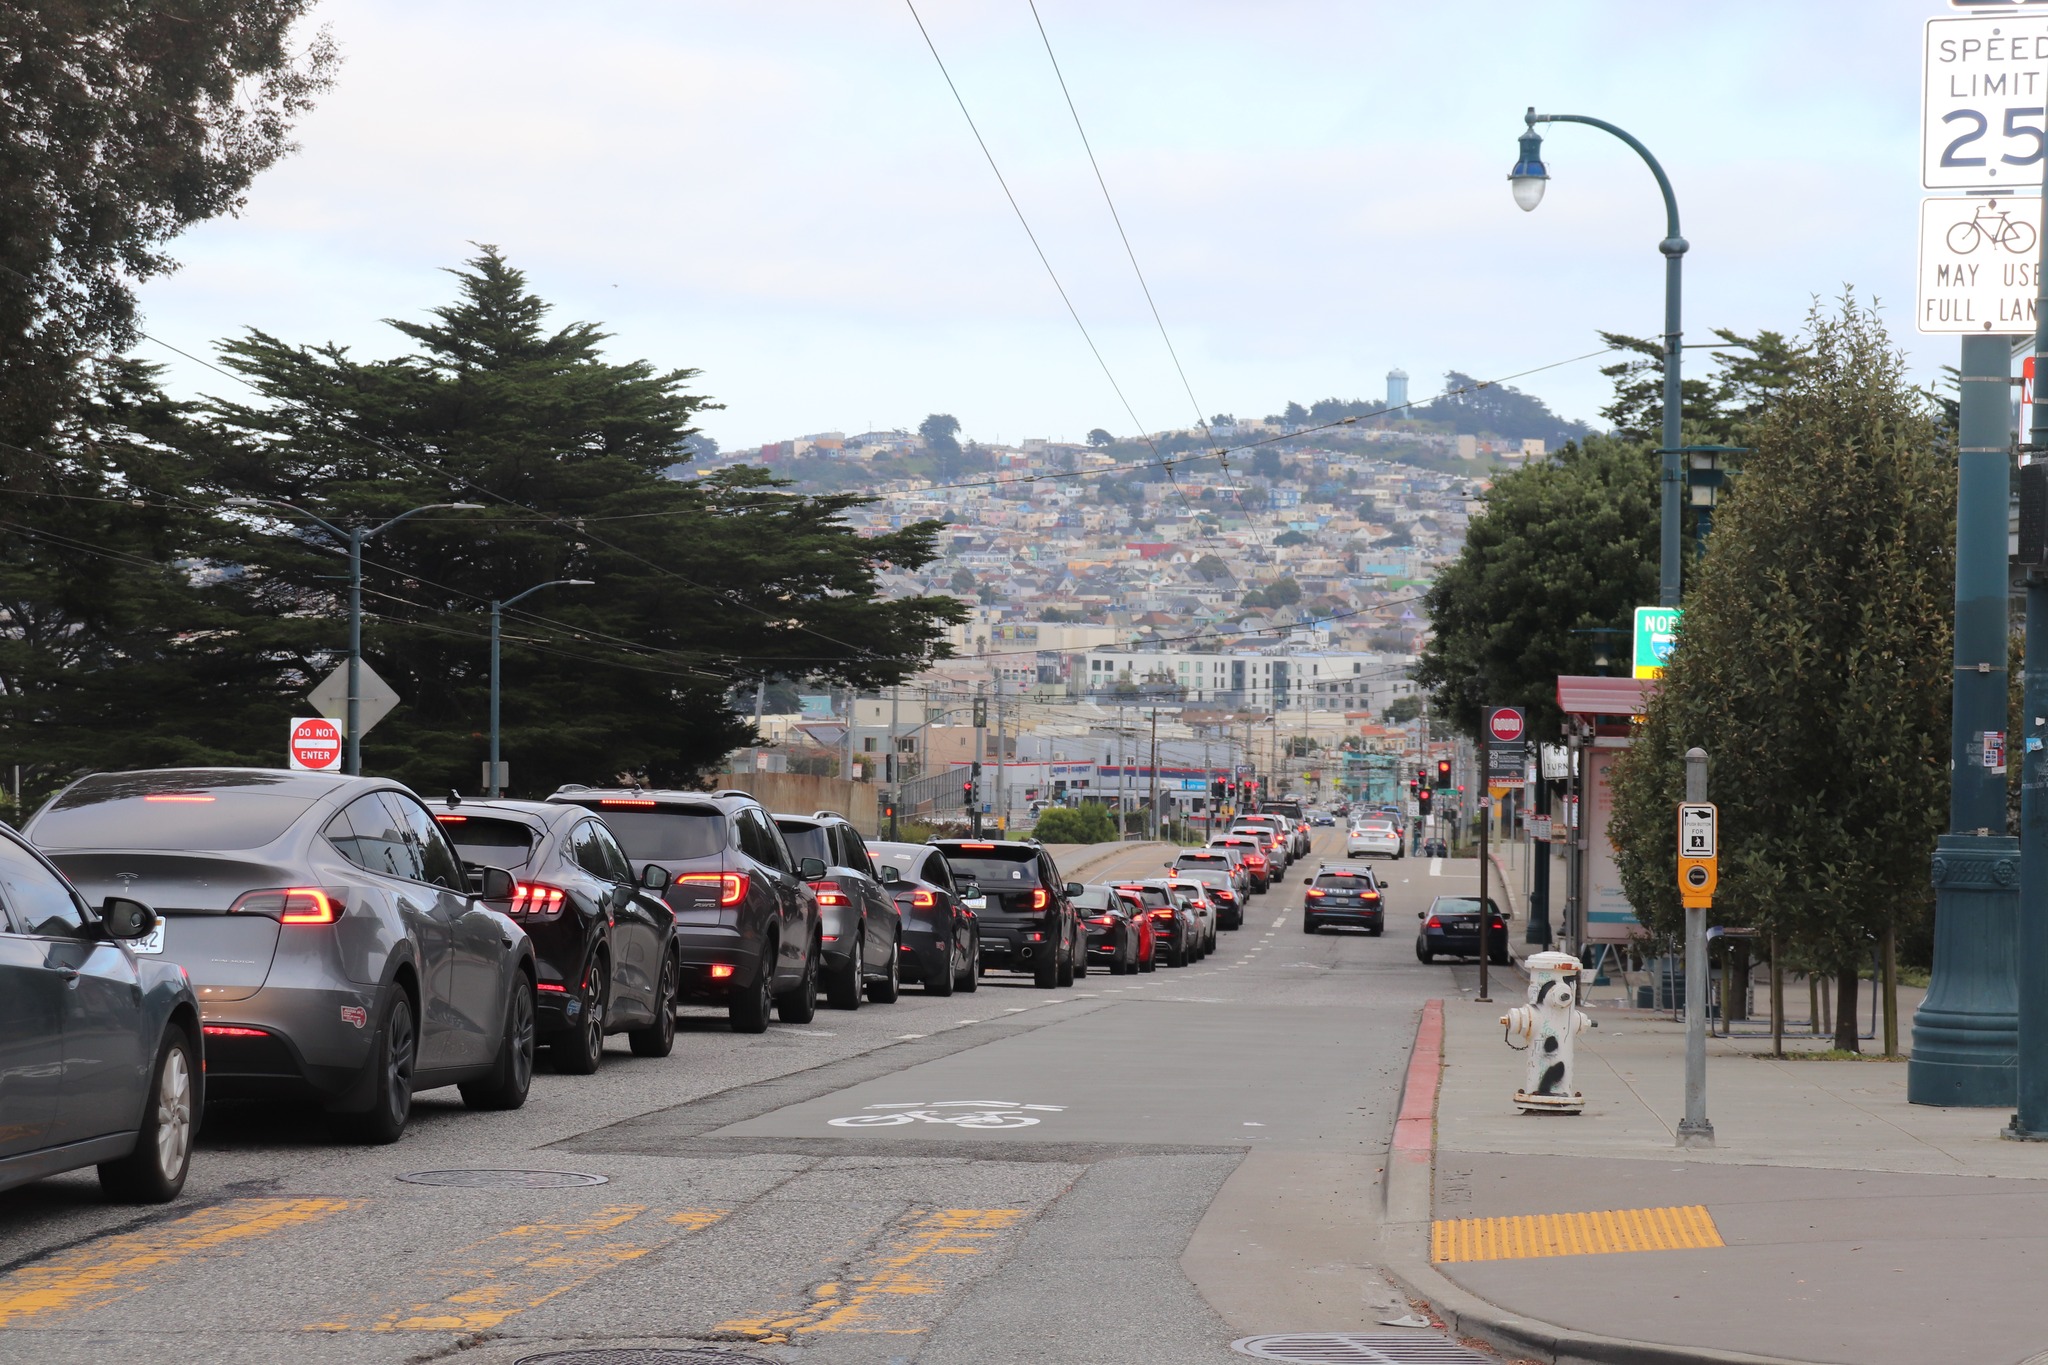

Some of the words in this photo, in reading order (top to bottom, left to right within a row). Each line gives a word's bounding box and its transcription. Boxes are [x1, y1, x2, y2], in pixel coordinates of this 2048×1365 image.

[1939, 36, 2048, 63] SPEED
[1950, 72, 2040, 98] LIMIT
[1940, 107, 2046, 168] 25
[1937, 263, 1979, 287] MAY
[2003, 262, 2039, 287] USE
[1926, 298, 1976, 321] FULL
[298, 728, 311, 736] DO
[316, 729, 334, 737] NOT
[301, 751, 330, 760] ENTER
[1489, 751, 1499, 760] 29
[1489, 760, 1498, 769] 49
[1547, 763, 1569, 771] TURN
